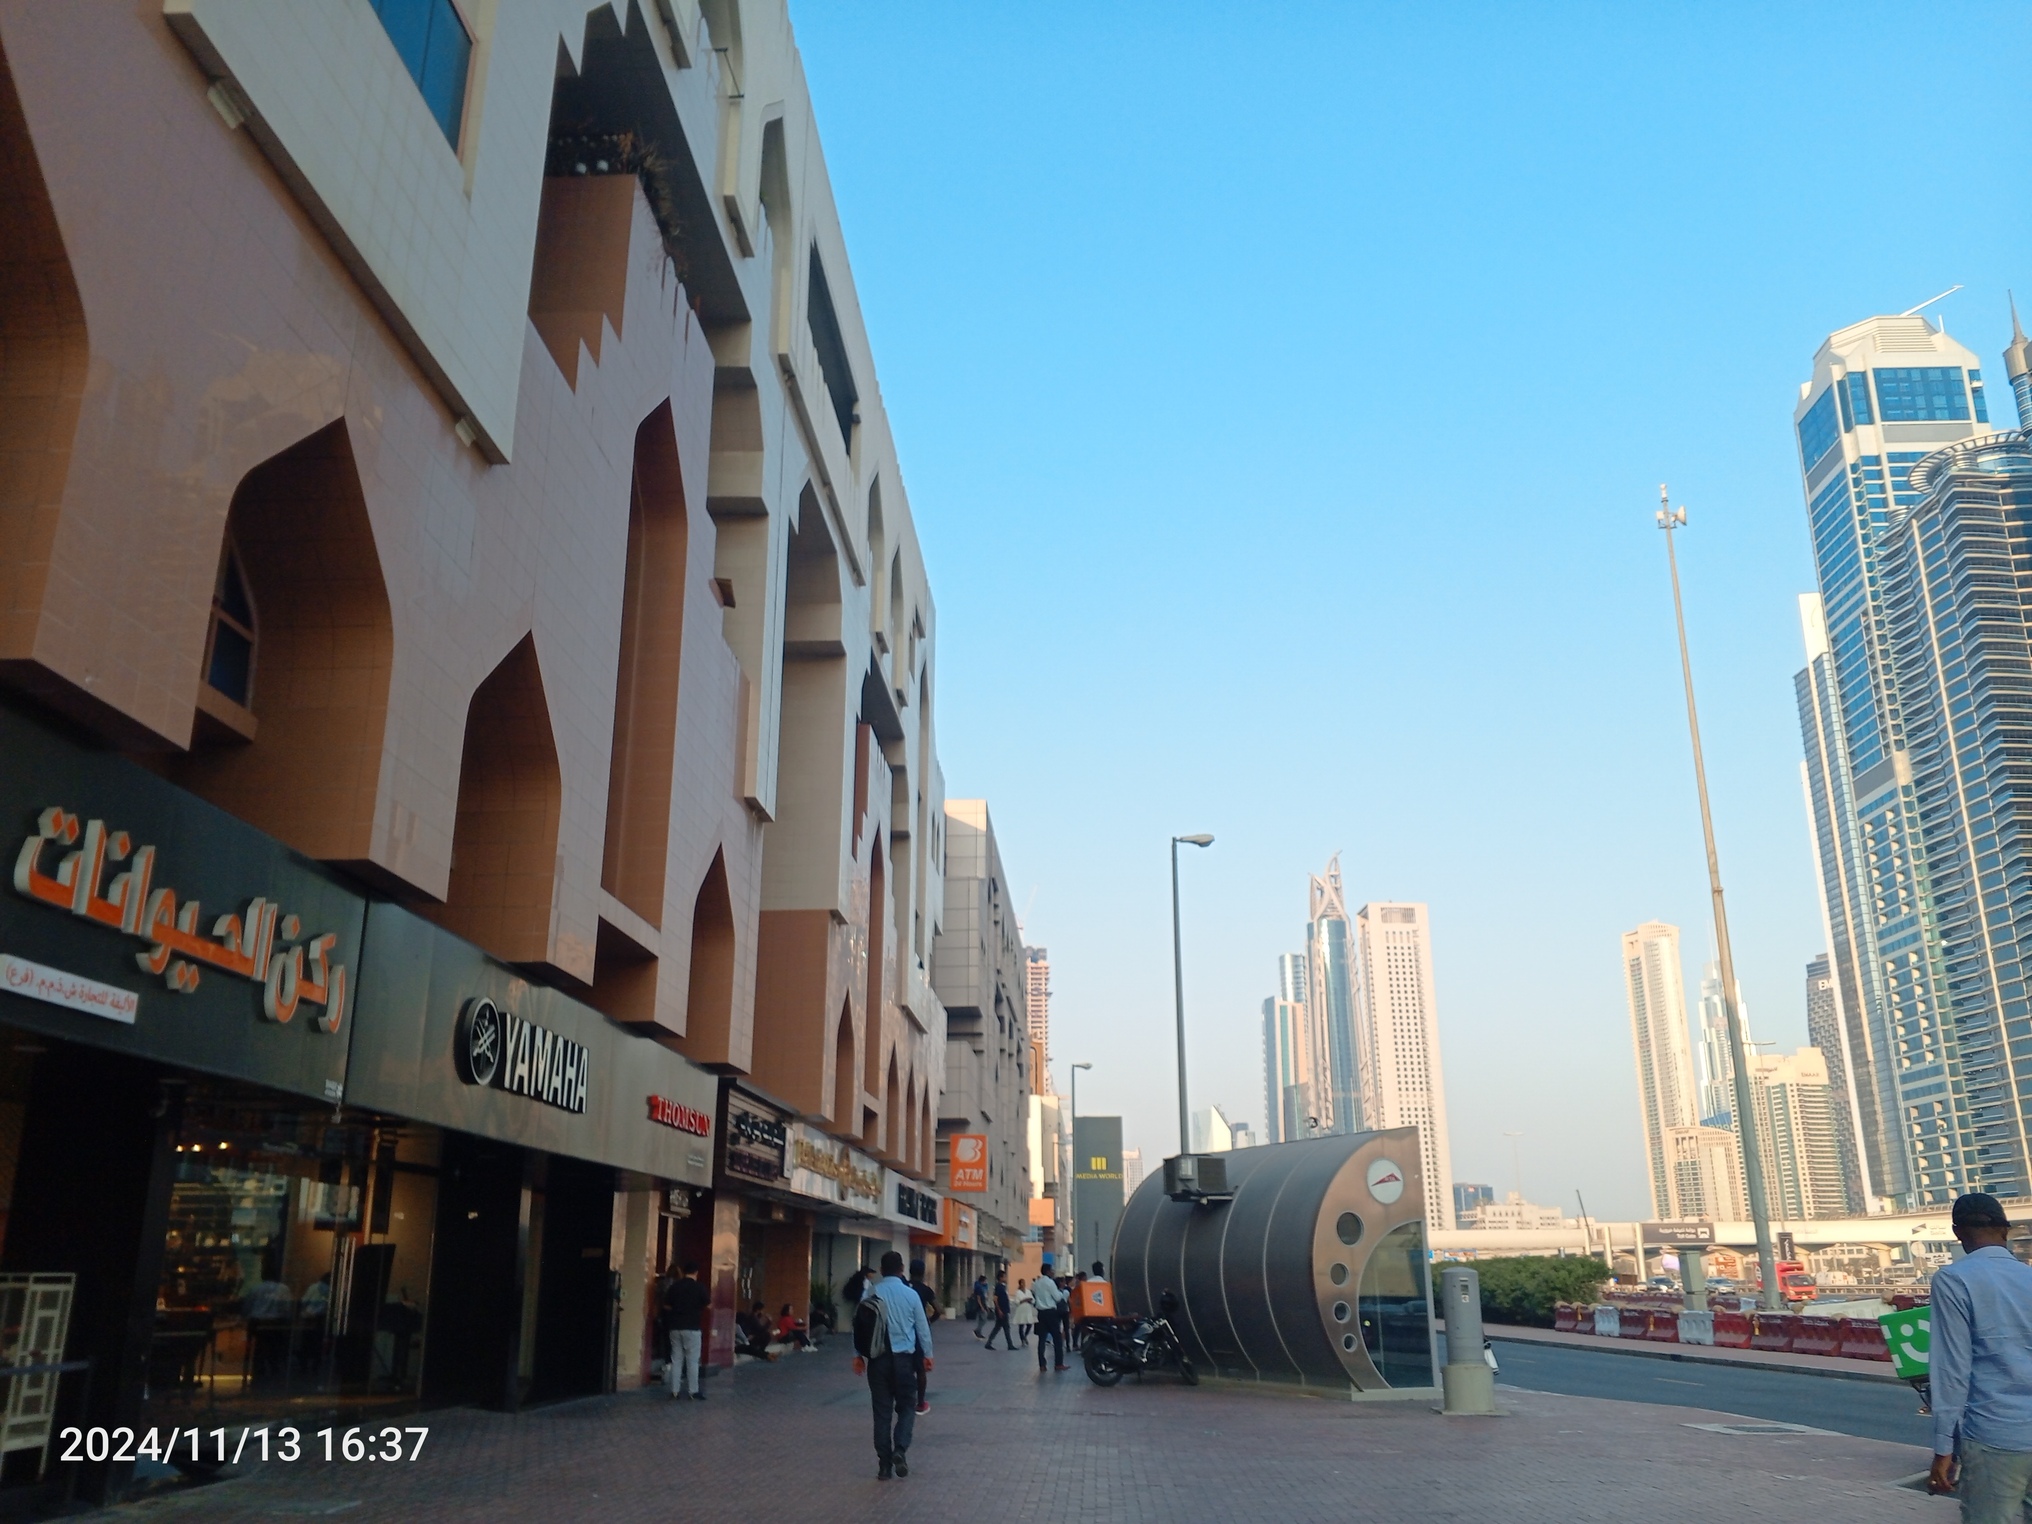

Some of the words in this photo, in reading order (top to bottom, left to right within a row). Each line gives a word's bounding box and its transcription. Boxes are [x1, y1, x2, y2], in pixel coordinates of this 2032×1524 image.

[13, 806, 278, 993] الحيوانات
[262, 913, 347, 1034] ركن
[502, 1012, 590, 1114] YAMAHA
[655, 1095, 711, 1137] THOMSUN
[955, 1168, 984, 1180] ATM
